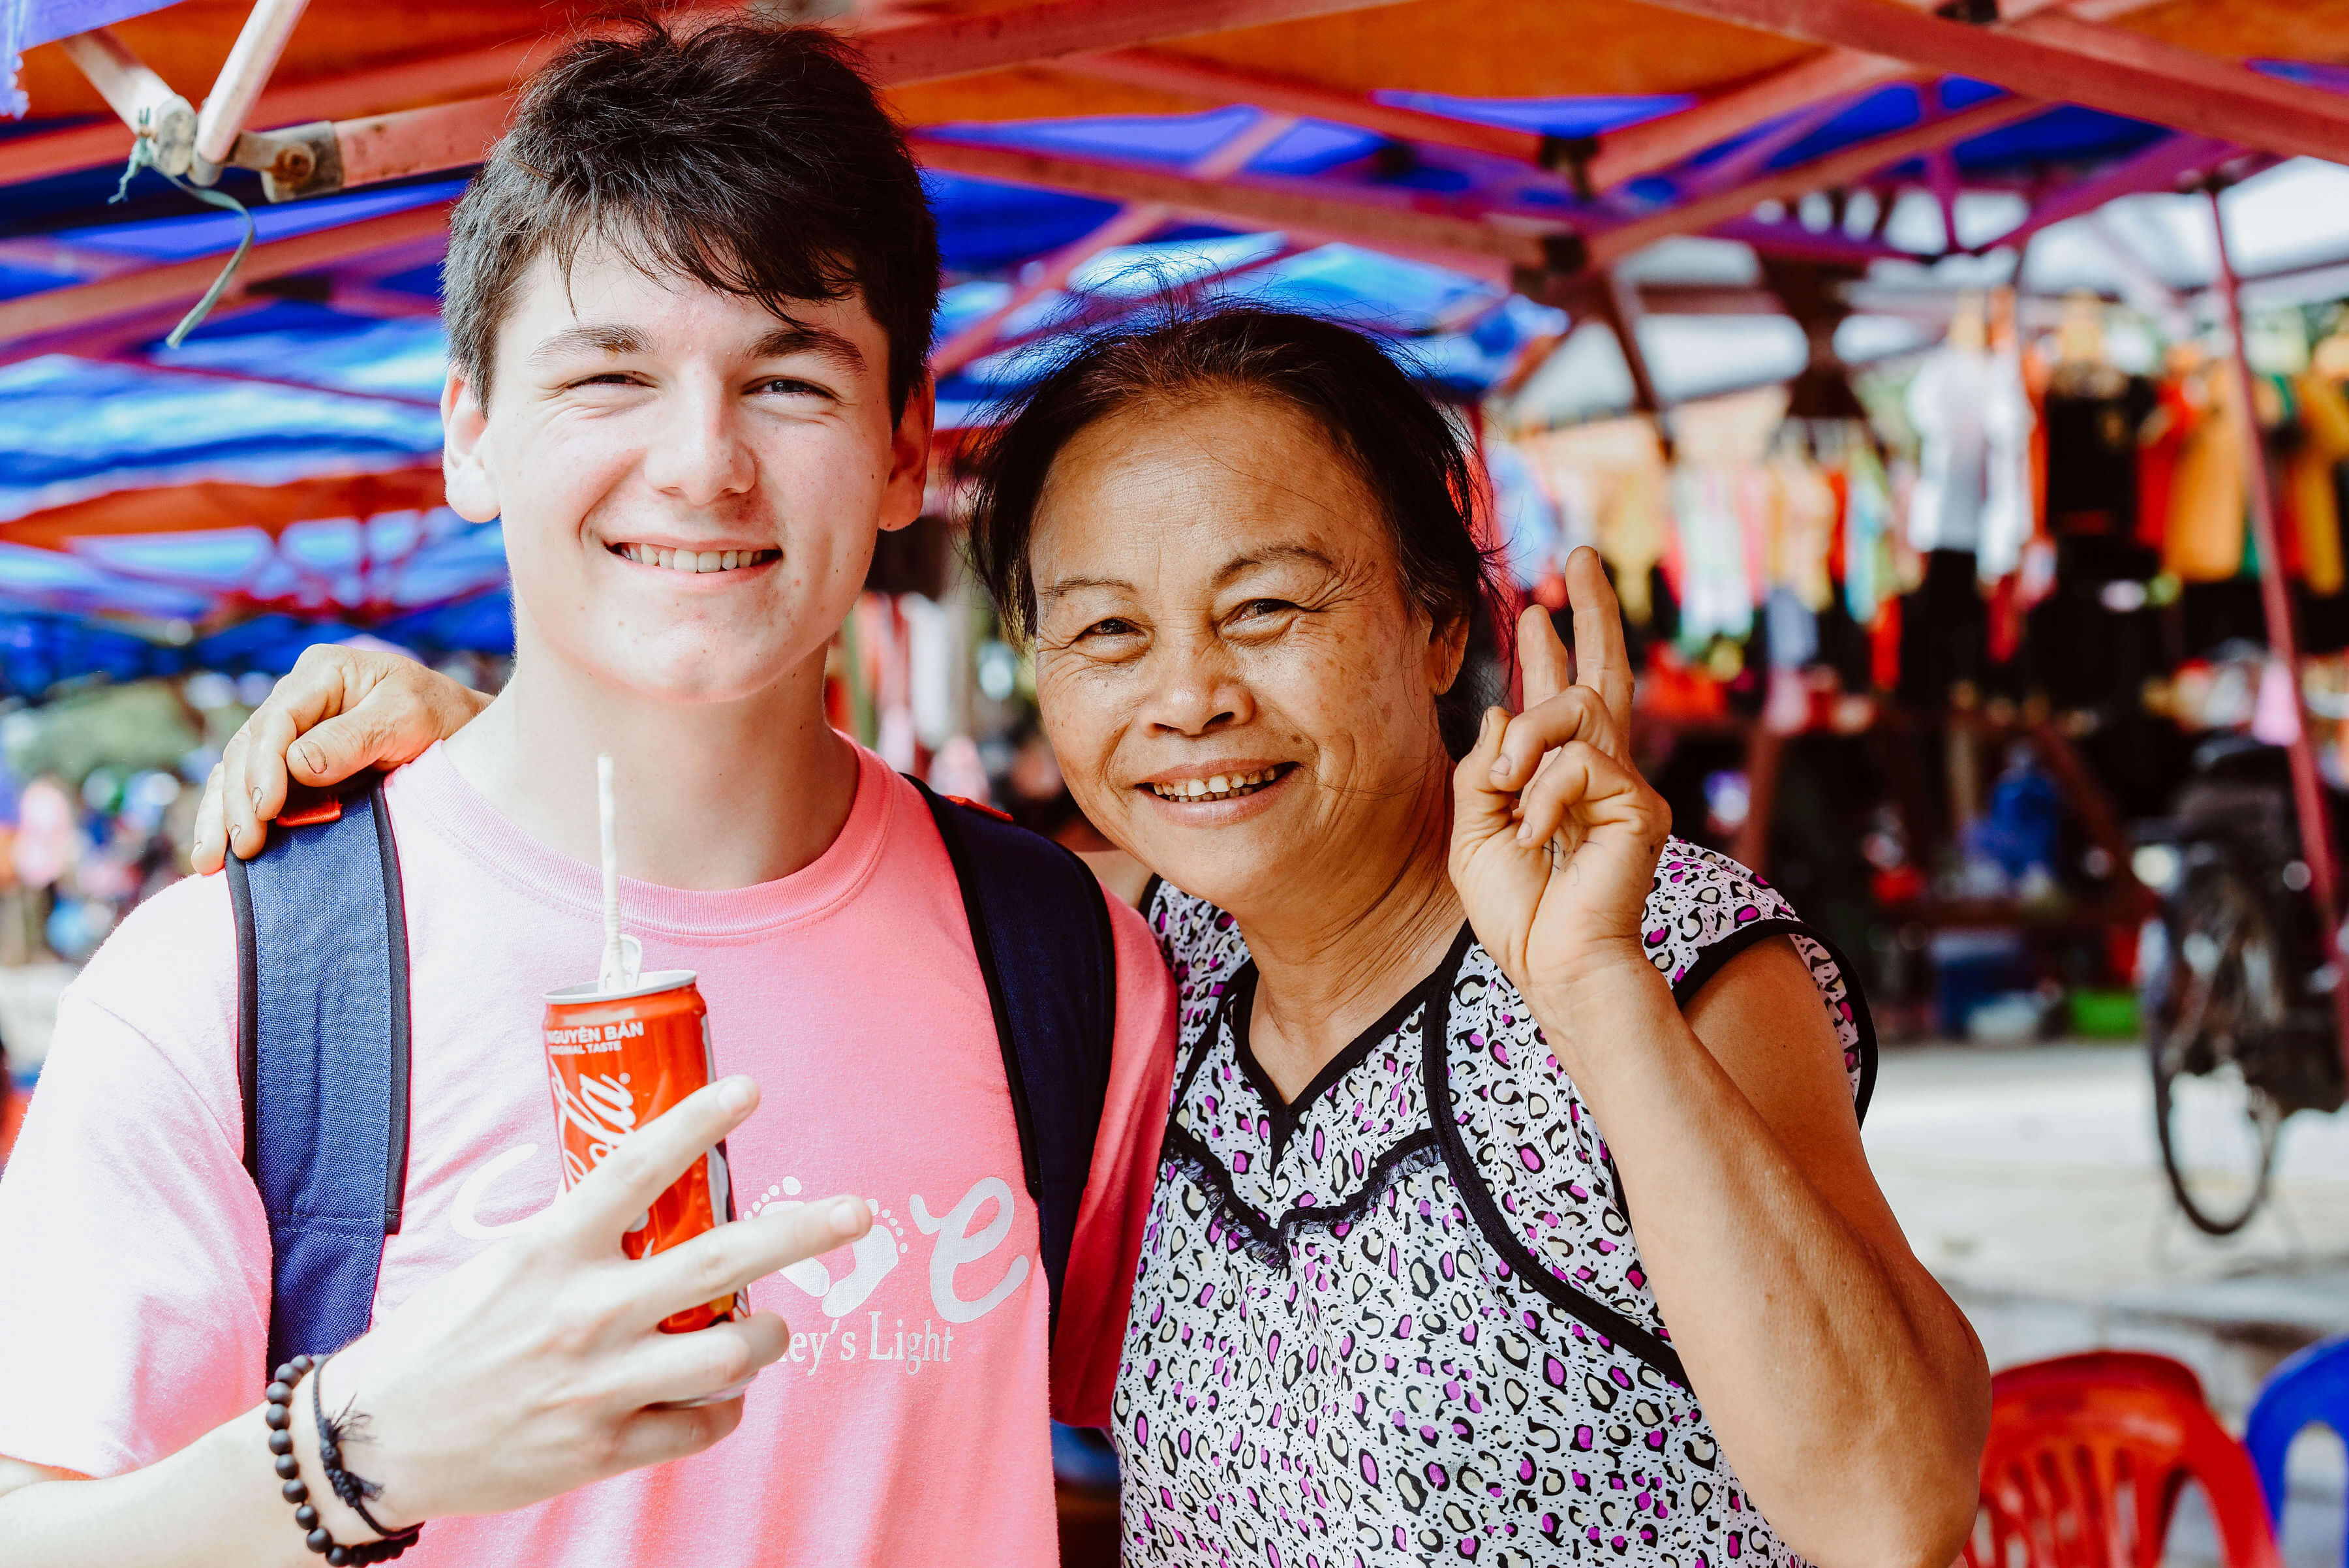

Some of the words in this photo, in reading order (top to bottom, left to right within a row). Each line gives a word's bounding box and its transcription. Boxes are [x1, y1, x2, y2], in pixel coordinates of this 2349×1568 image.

[585, 1040, 622, 1054] TASTE
[778, 1319, 856, 1376] ey's
[868, 1311, 954, 1376] Light
